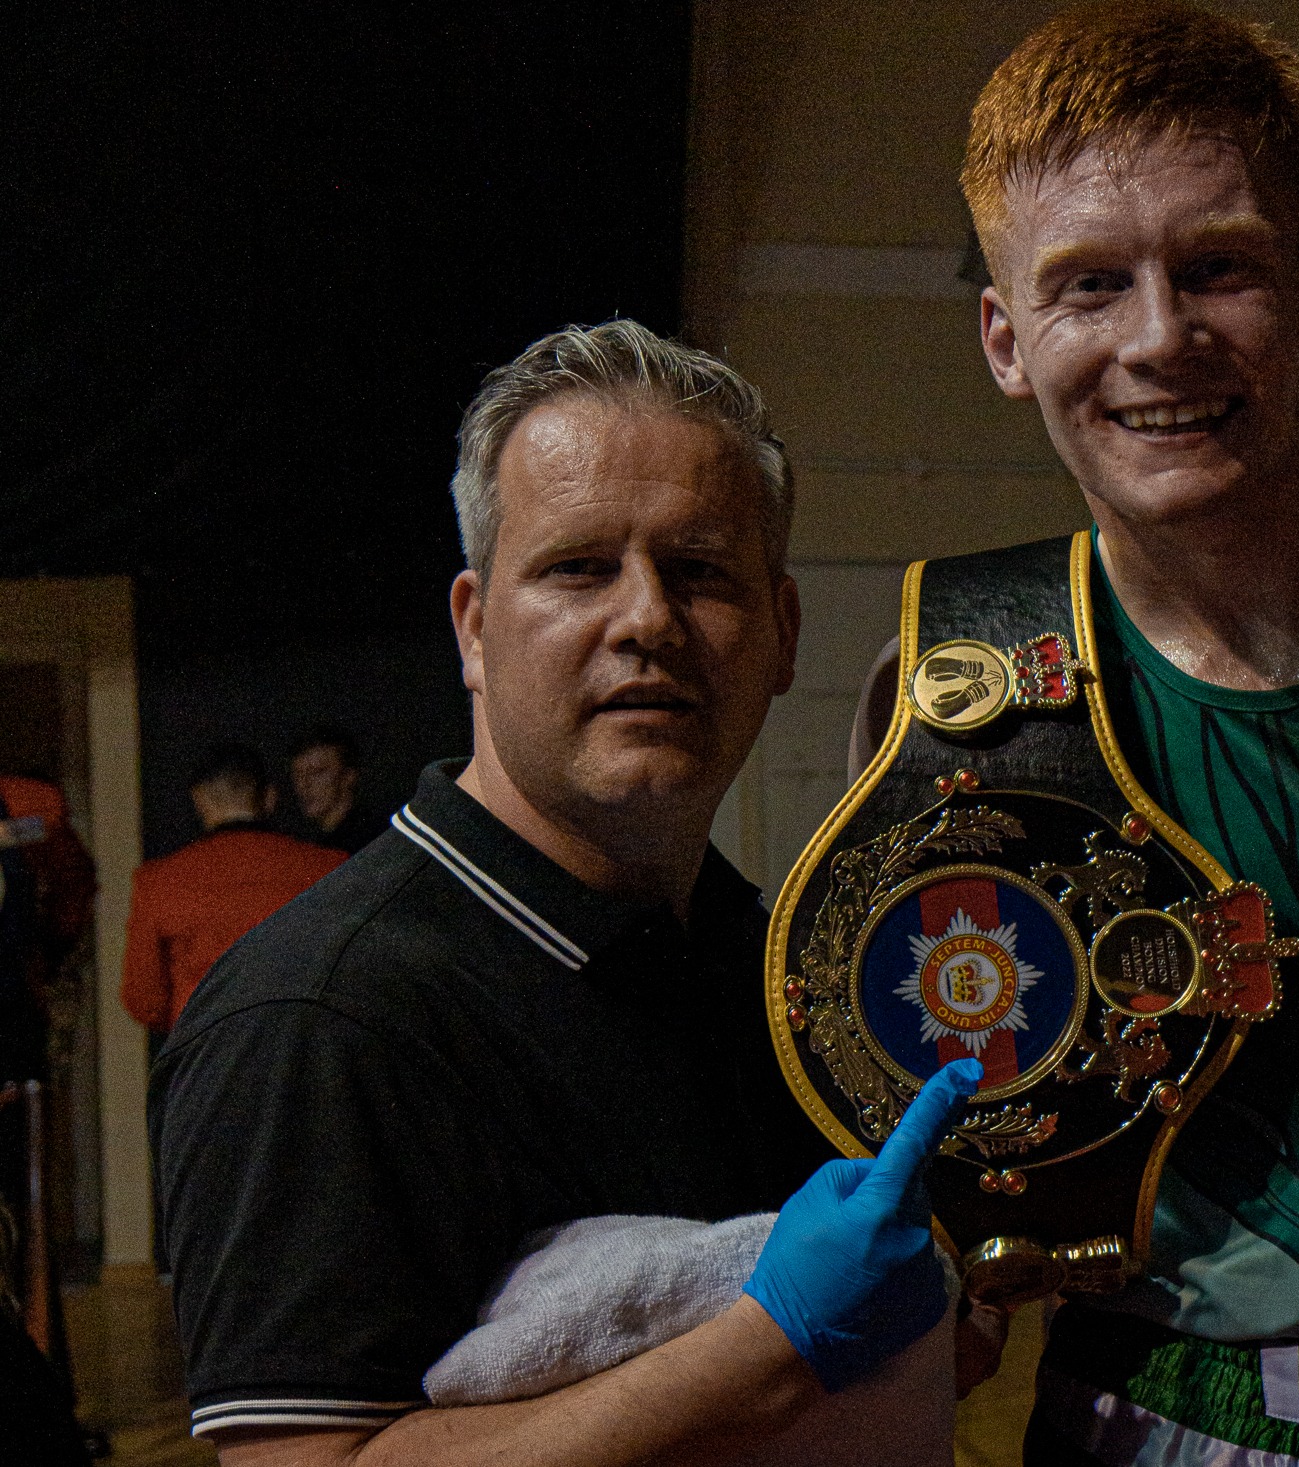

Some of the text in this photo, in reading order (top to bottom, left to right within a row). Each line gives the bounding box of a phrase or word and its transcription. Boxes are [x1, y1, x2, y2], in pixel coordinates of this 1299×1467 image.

[930, 939, 1014, 1027] SEPTEM JUNCTA IN UNO
[1121, 952, 1132, 978] 2022
[1130, 936, 1145, 990] CHAMPION
[1143, 941, 1156, 983] BOXING
[1154, 937, 1168, 984] DIVISION
[1165, 928, 1180, 990] HOUSEHOLD
